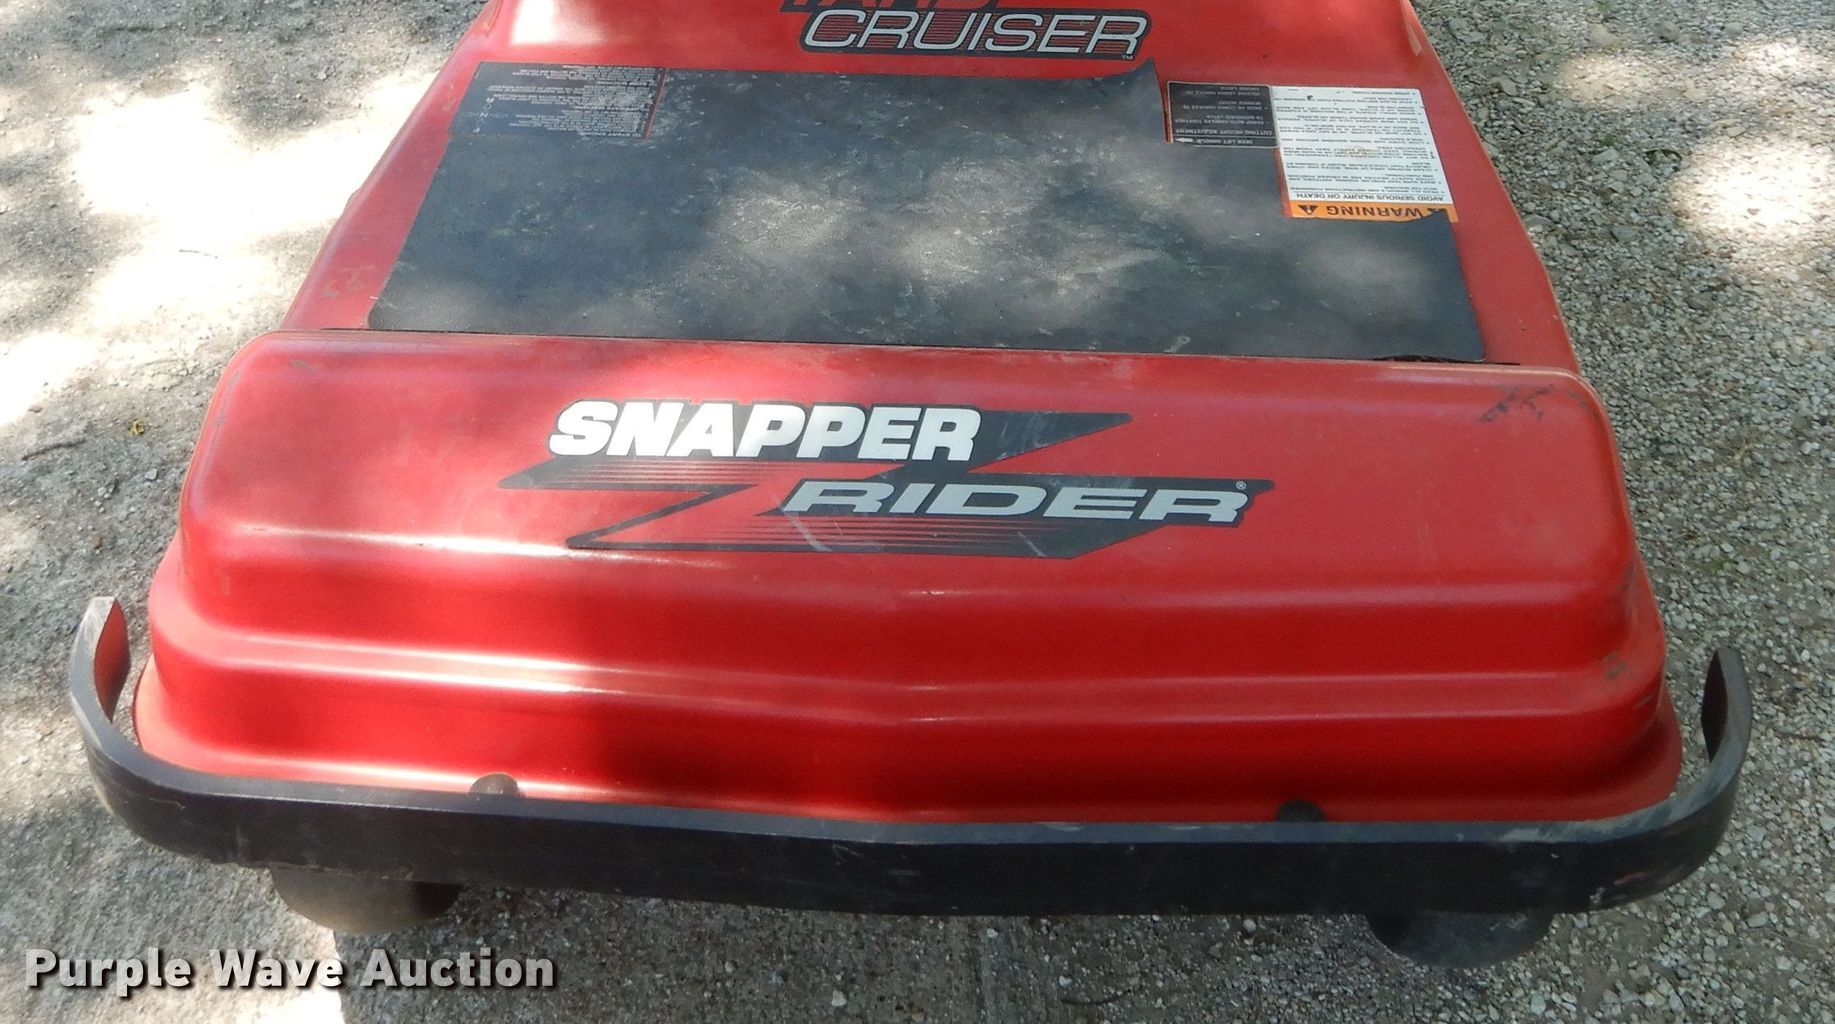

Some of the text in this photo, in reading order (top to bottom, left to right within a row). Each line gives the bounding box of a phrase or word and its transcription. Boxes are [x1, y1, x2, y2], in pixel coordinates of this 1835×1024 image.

[804, 9, 1149, 56] CRUISER
[1327, 205, 1425, 218] WARNING
[549, 400, 982, 461] SNAPPER
[781, 480, 1250, 523] RIDER
